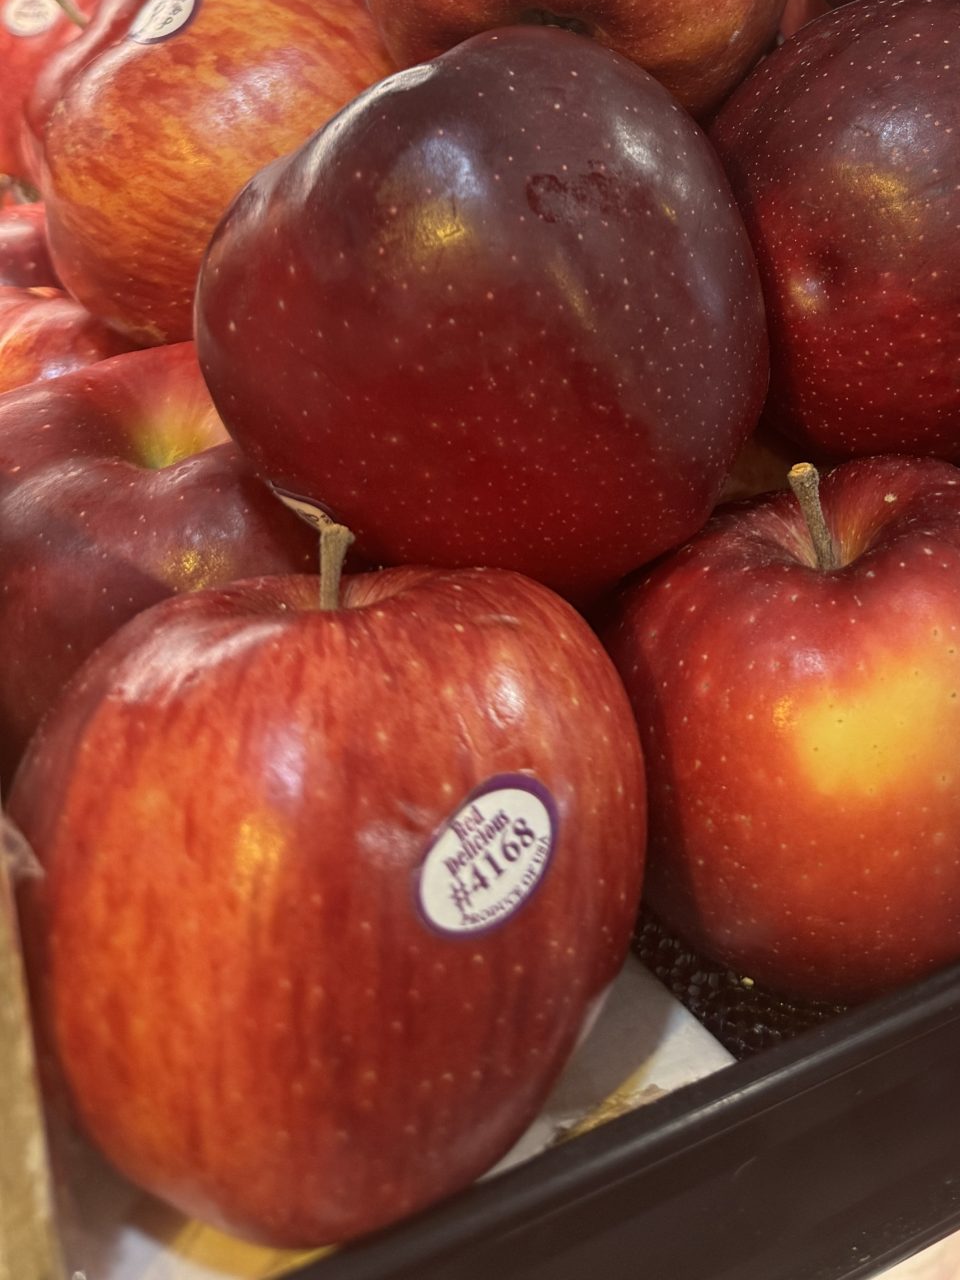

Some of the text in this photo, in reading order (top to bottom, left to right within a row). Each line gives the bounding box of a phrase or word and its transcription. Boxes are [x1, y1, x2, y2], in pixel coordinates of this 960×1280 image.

[443, 809, 510, 878] Delicious
[449, 805, 485, 840] Red
[450, 817, 536, 910] #4168
